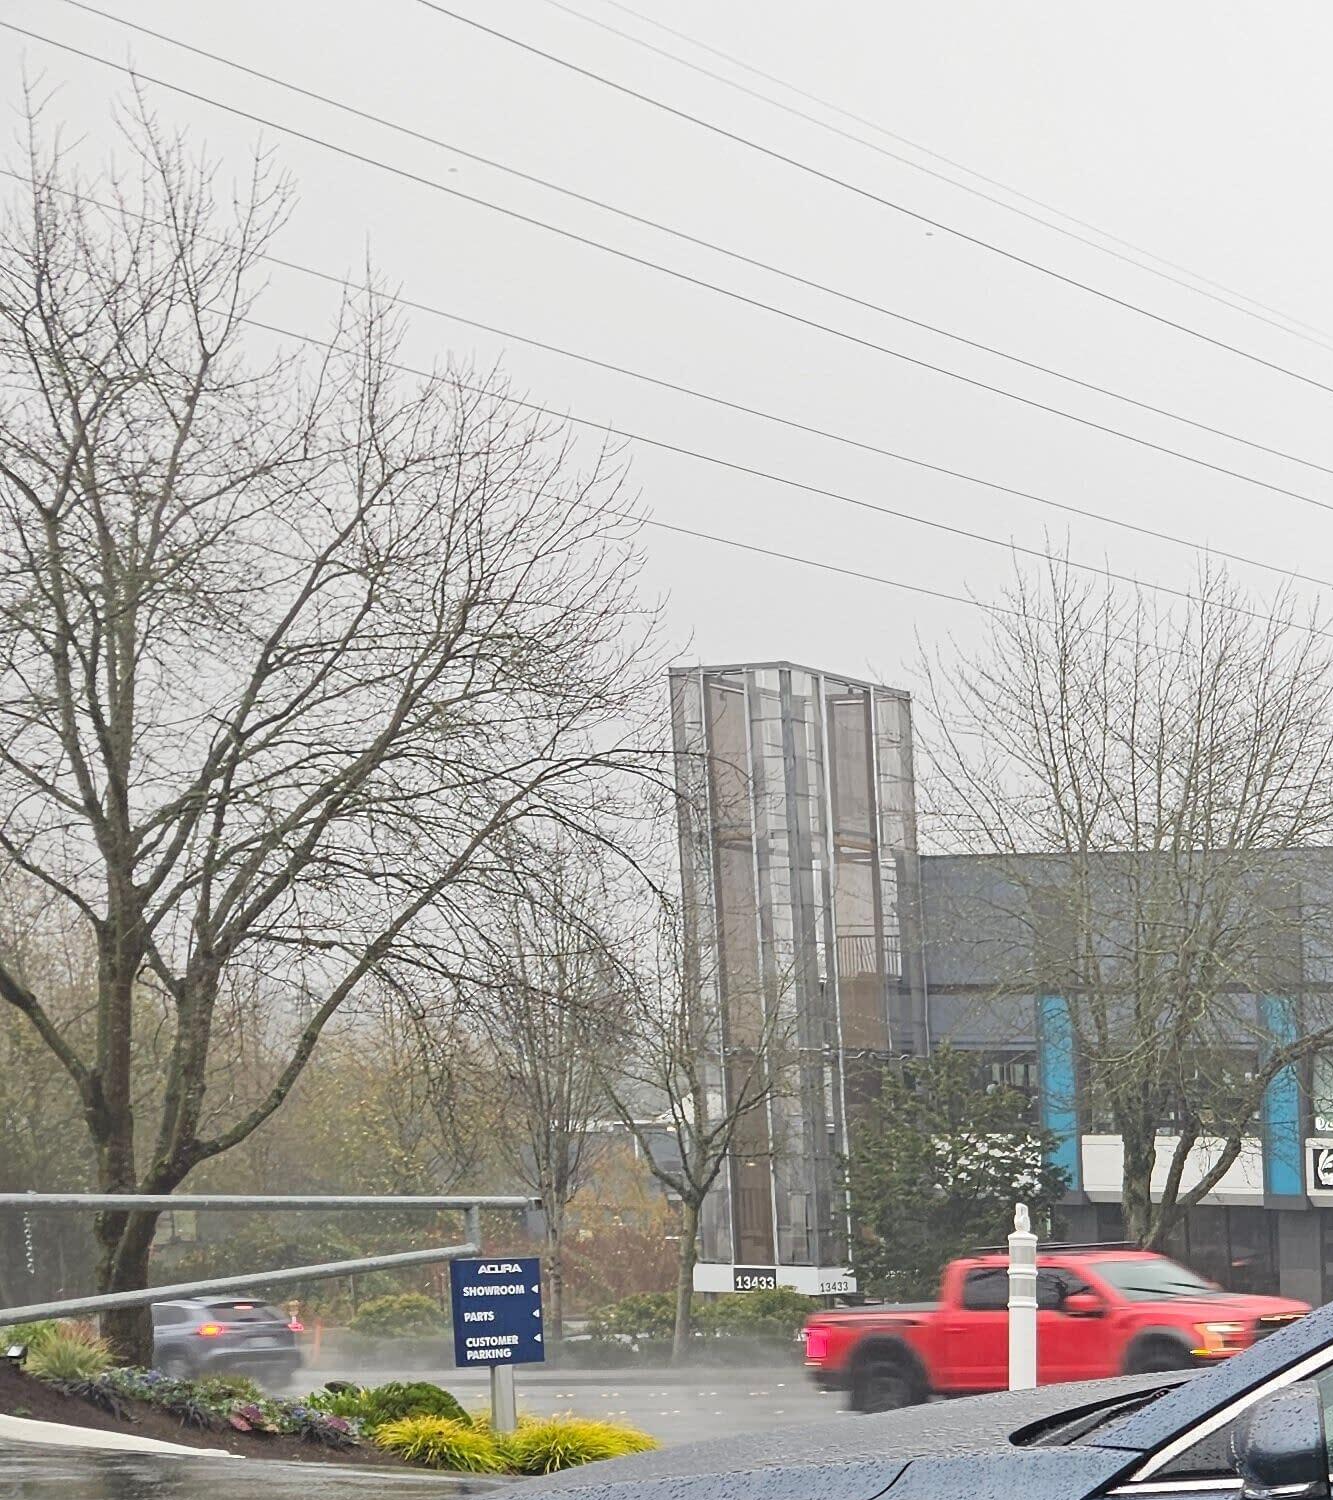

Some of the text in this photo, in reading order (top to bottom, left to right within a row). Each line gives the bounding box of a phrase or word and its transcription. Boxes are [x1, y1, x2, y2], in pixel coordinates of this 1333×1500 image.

[478, 1263, 522, 1274] ACURA
[735, 1275, 775, 1290] 13433
[820, 1281, 849, 1293] 13433
[463, 1284, 525, 1297] SHOWROOM
[464, 1311, 495, 1322] PARTS
[466, 1335, 519, 1347] CUSTOMER
[467, 1348, 512, 1360] PARKING
